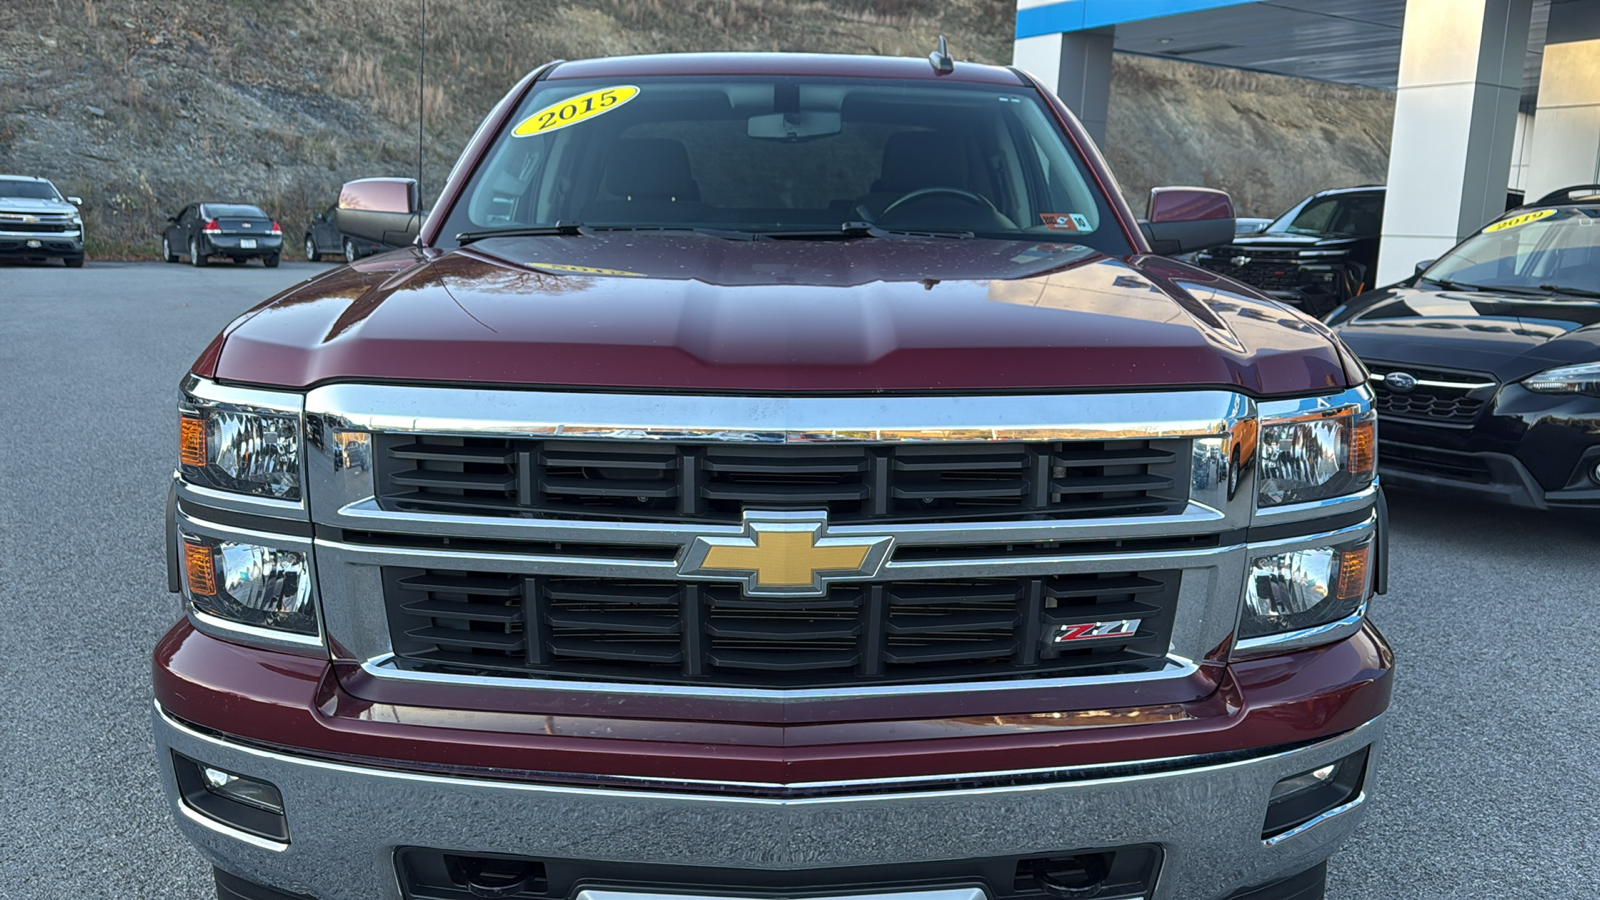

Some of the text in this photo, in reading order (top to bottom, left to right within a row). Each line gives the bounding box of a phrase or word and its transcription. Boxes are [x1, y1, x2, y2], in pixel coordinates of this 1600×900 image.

[538, 90, 617, 130] 2015
[1074, 217, 1086, 227] 10
[1496, 212, 1544, 230] 2019
[1055, 619, 1141, 642] Z71
